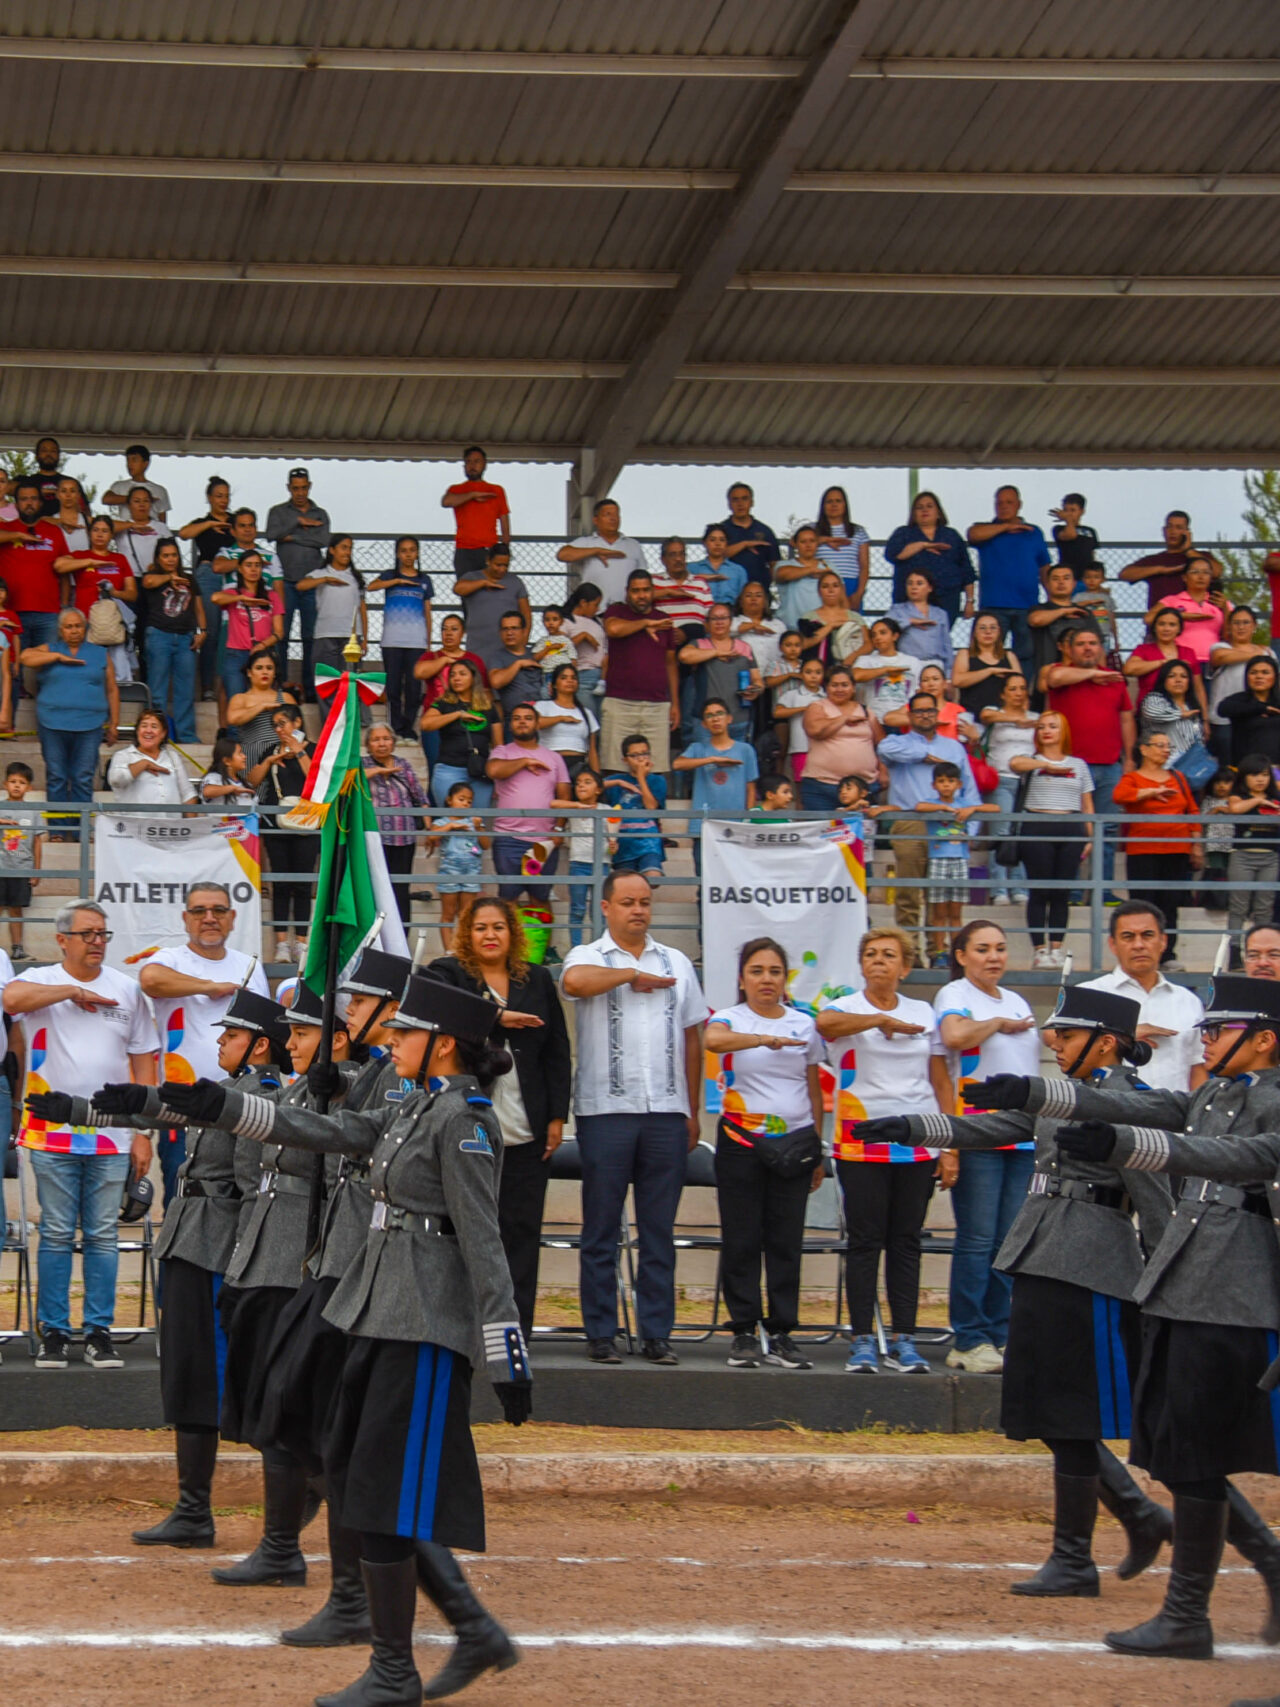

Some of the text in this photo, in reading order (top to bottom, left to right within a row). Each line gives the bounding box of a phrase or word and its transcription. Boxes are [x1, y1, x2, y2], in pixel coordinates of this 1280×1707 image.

[146, 826, 191, 836] SEED
[755, 833, 801, 843] SEED
[97, 881, 253, 904] ATLETIO
[709, 886, 857, 907] BASQUETBOL
[102, 1011, 129, 1021] SEED
